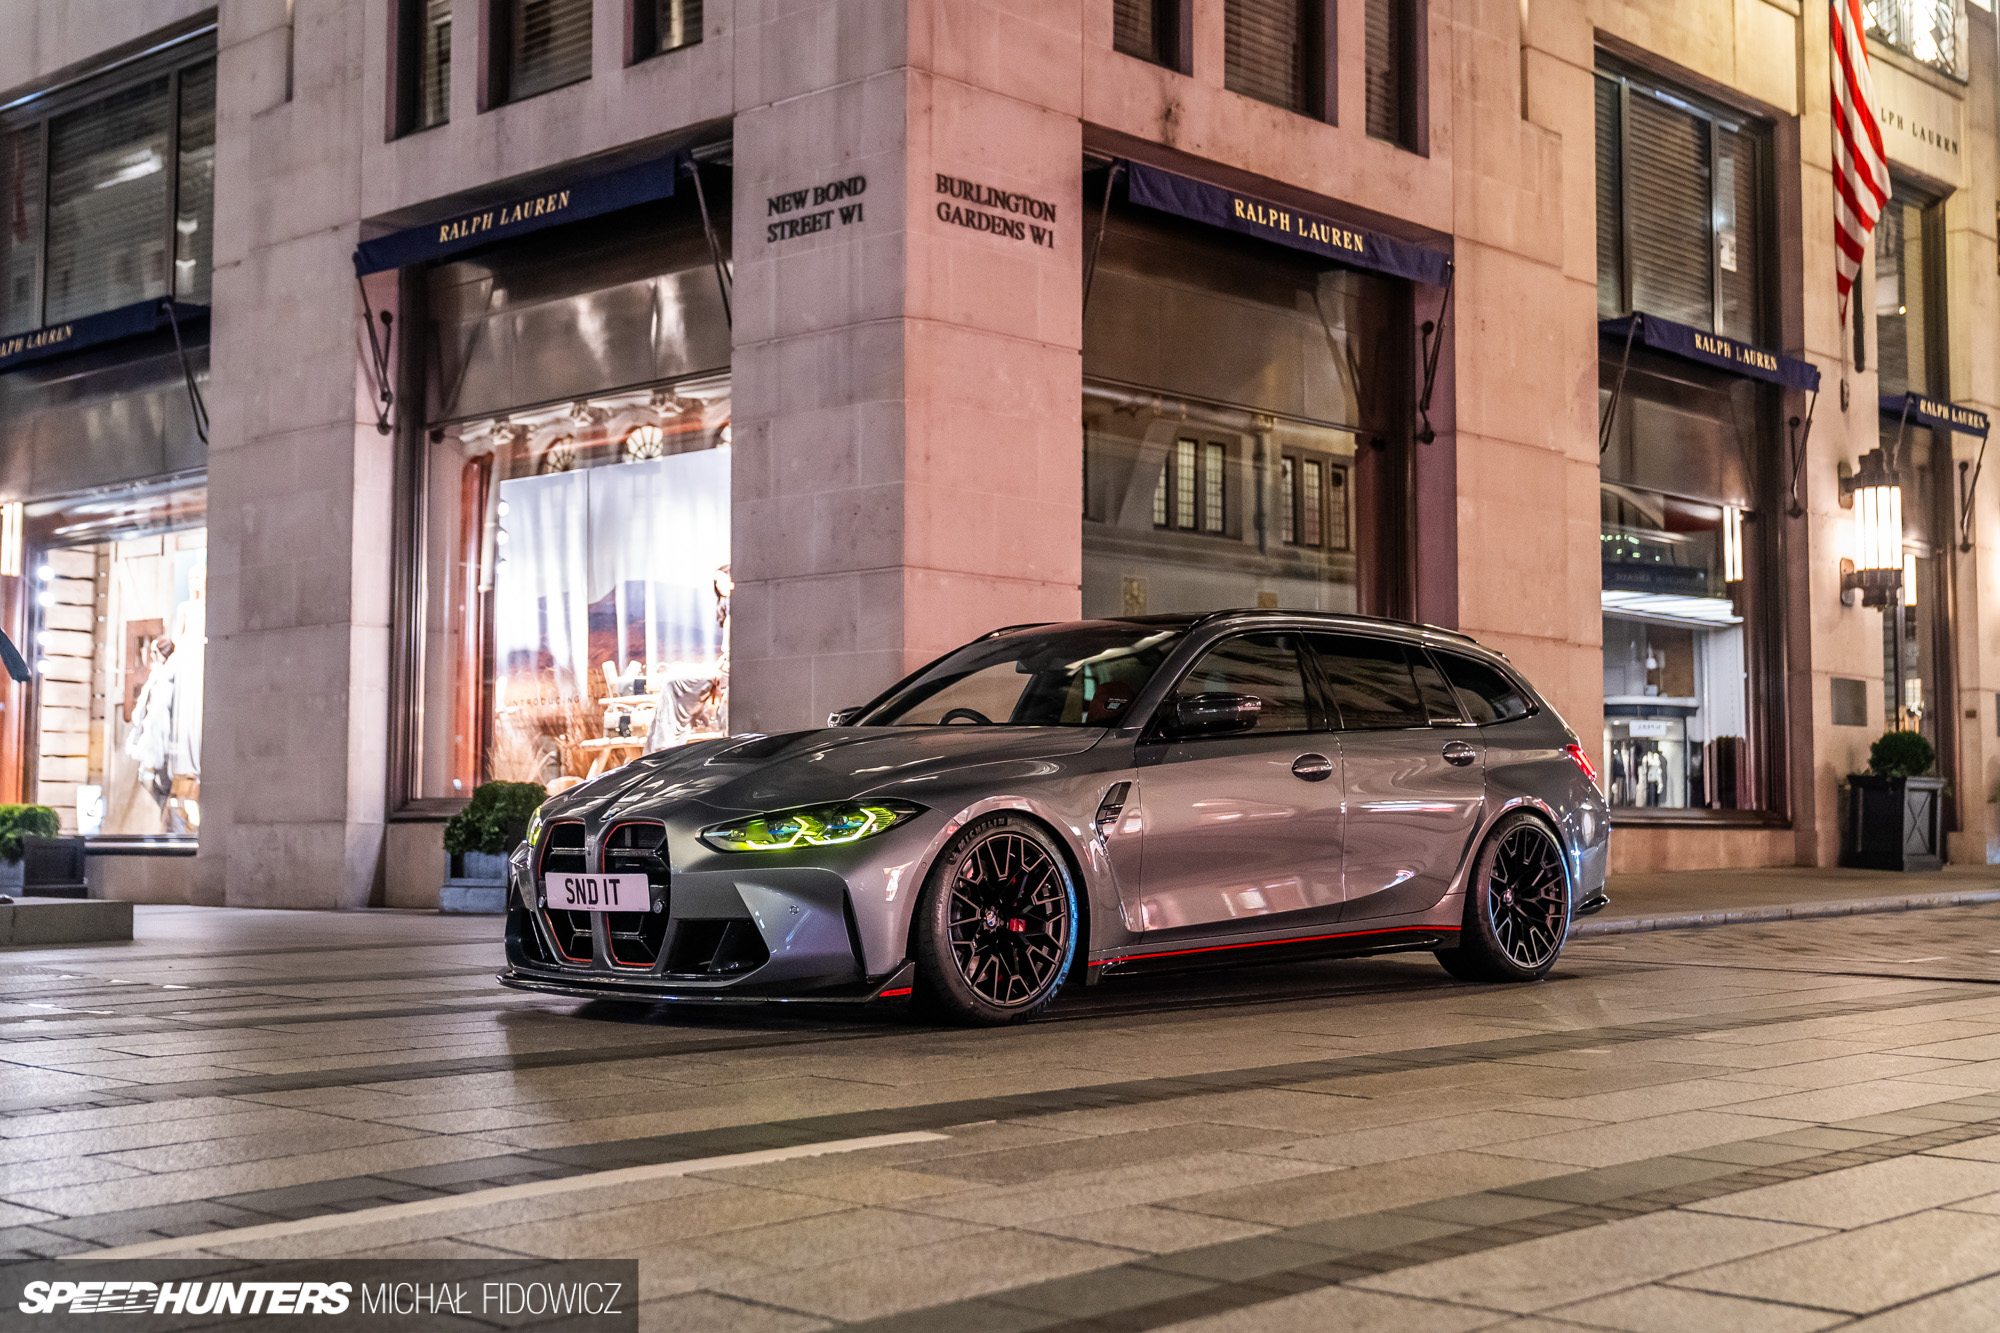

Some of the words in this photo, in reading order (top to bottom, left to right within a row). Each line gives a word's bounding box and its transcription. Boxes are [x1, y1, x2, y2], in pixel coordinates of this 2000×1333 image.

[1881, 107, 1903, 131] LPH
[1912, 121, 1958, 155] LAUREN
[439, 212, 494, 243] RALPH
[500, 190, 570, 226] LAUREN
[767, 189, 809, 217] NEW
[813, 175, 867, 206] BOND
[935, 172, 1057, 223] BURLINGTON
[767, 209, 835, 243] STREET
[838, 202, 865, 224] W1
[936, 201, 1026, 241] GARDENS
[1030, 224, 1055, 249] W1
[1234, 198, 1291, 232] RALPH
[1298, 217, 1364, 253] LAUREN
[26, 325, 72, 349] LAUREN
[1694, 333, 1731, 359] RALPH
[1736, 345, 1778, 371] LAUREN
[1919, 398, 1949, 420] RALPH
[1951, 408, 1985, 429] LAUREN
[957, 817, 1006, 851] MICHELIN
[565, 878, 598, 905] SND
[603, 879, 620, 905] IT
